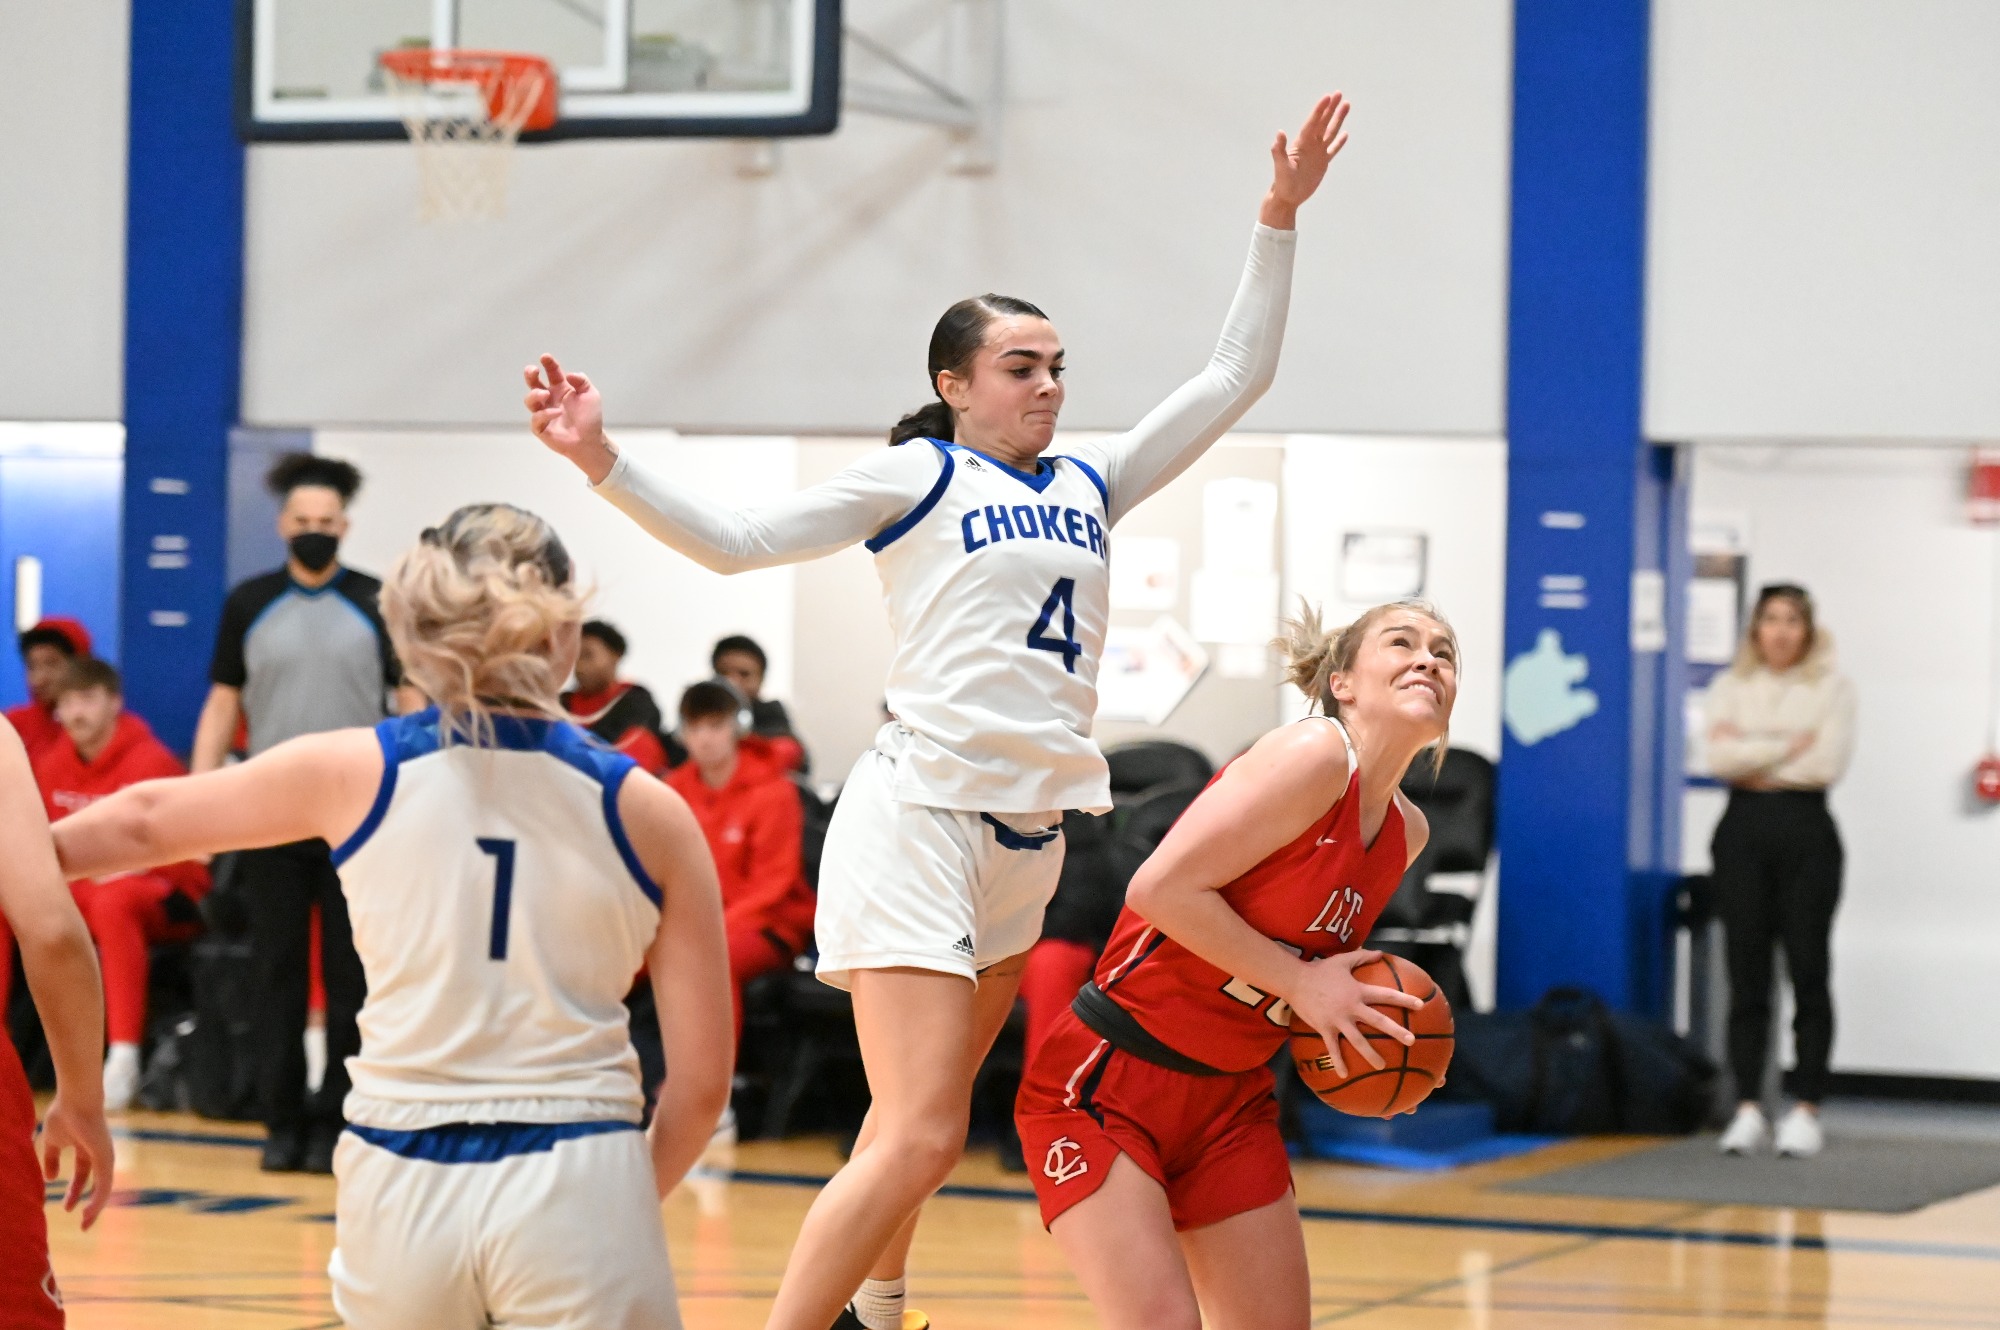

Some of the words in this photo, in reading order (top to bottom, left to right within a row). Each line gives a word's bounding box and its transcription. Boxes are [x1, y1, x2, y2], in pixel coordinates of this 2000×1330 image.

[961, 504, 1106, 561] CHOKER
[1026, 575, 1082, 674] 4
[475, 837, 517, 961] 1
[1304, 886, 1364, 944] LCC
[952, 944, 975, 957] adida
